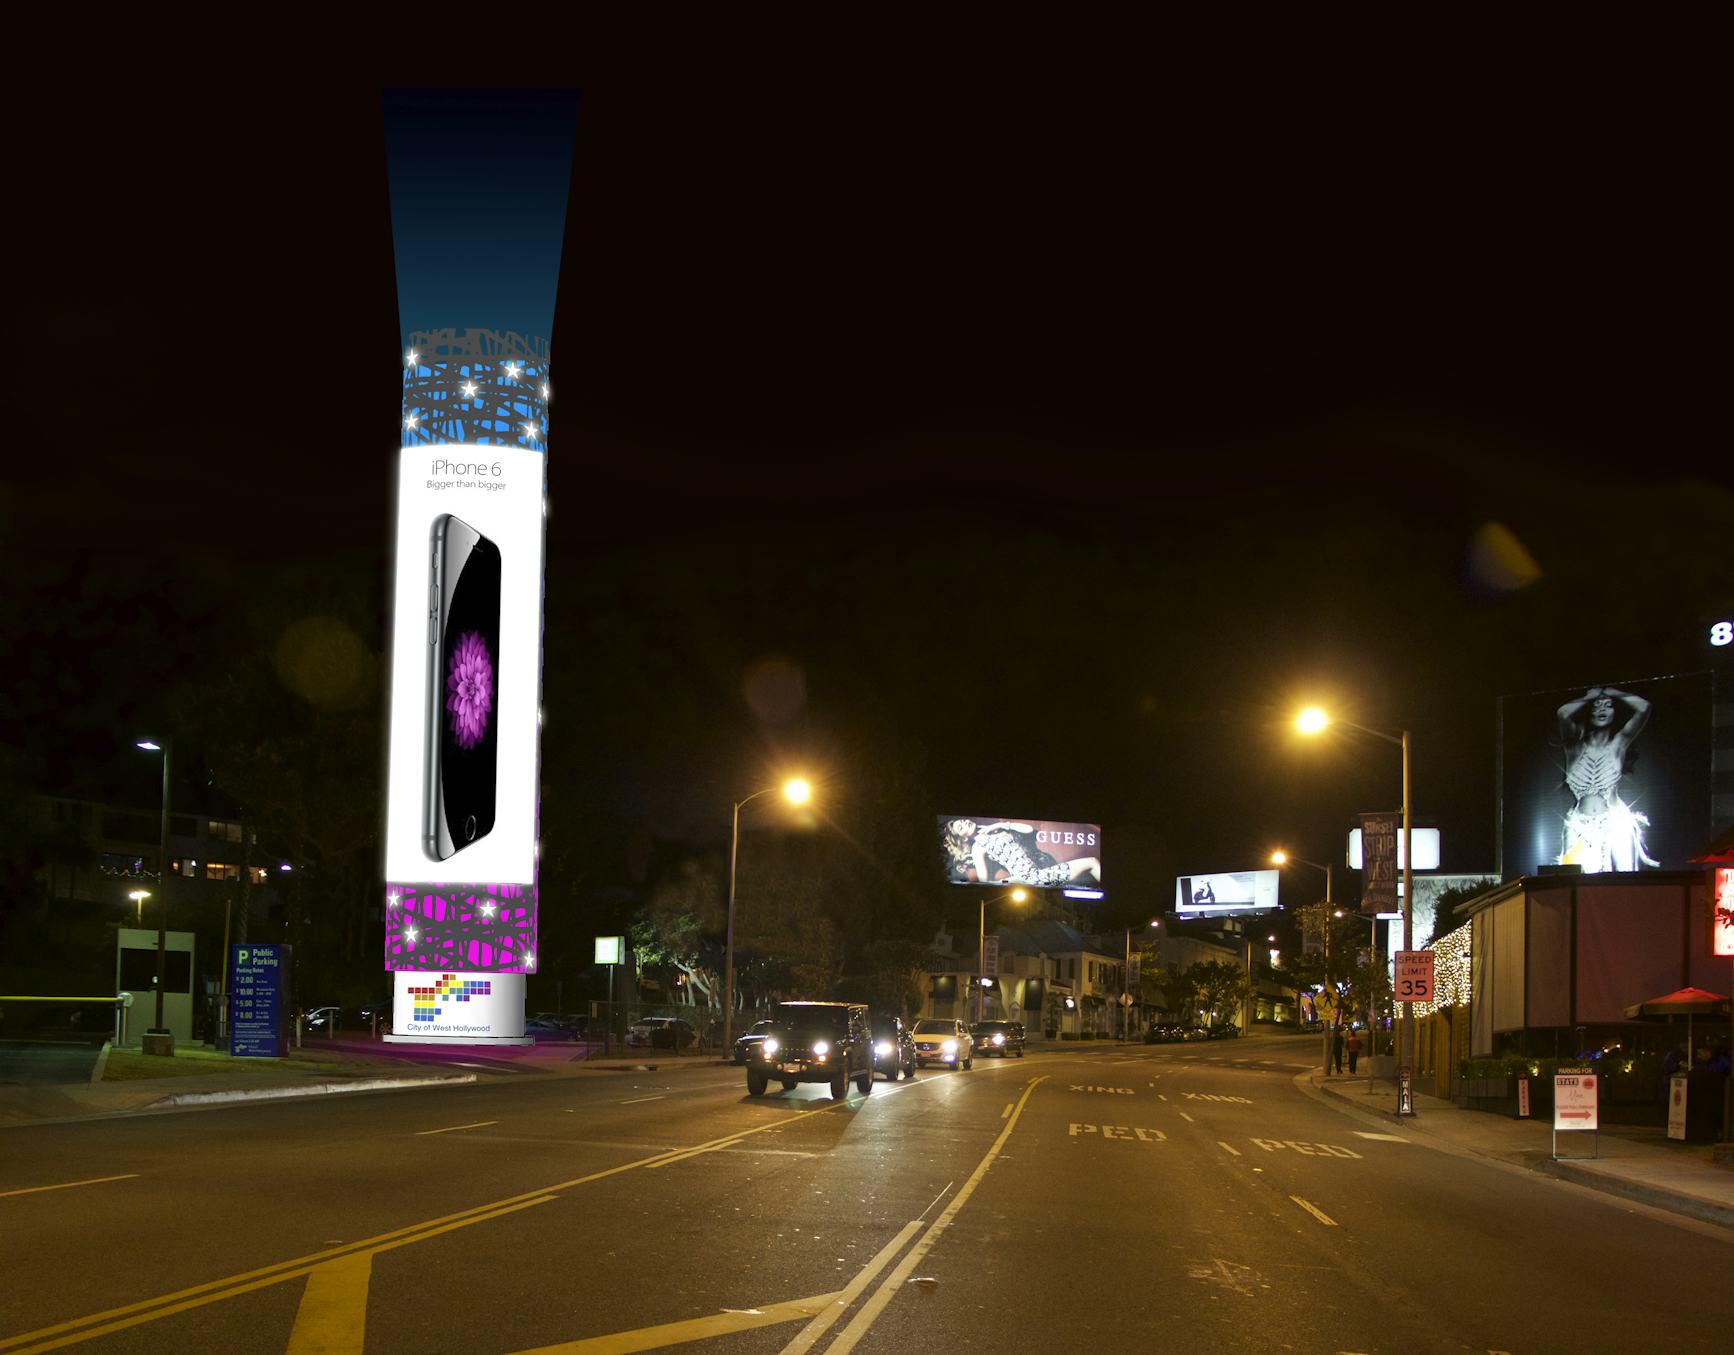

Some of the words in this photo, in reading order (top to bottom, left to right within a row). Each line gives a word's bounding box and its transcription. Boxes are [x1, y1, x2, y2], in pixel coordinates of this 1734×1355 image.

[432, 459, 488, 476] iPhone
[491, 461, 502, 477] 6
[426, 480, 454, 490] Bigger
[456, 480, 476, 489] than
[478, 480, 506, 491] bigger
[1036, 831, 1096, 846] GUESS
[1364, 835, 1394, 858] STRIP
[238, 950, 249, 964] P
[252, 948, 274, 957] Public
[252, 957, 278, 967] Parking
[1398, 955, 1432, 964] SPEED
[1401, 968, 1428, 976] LIMIT
[1400, 980, 1428, 996] 35
[407, 1023, 421, 1032] City
[423, 1024, 431, 1032] of
[432, 1024, 452, 1032] West
[453, 1024, 491, 1033] Hollywood
[1069, 1085, 1135, 1095] XING
[1069, 1123, 1168, 1142] PED
[1249, 1137, 1363, 1159] PED
